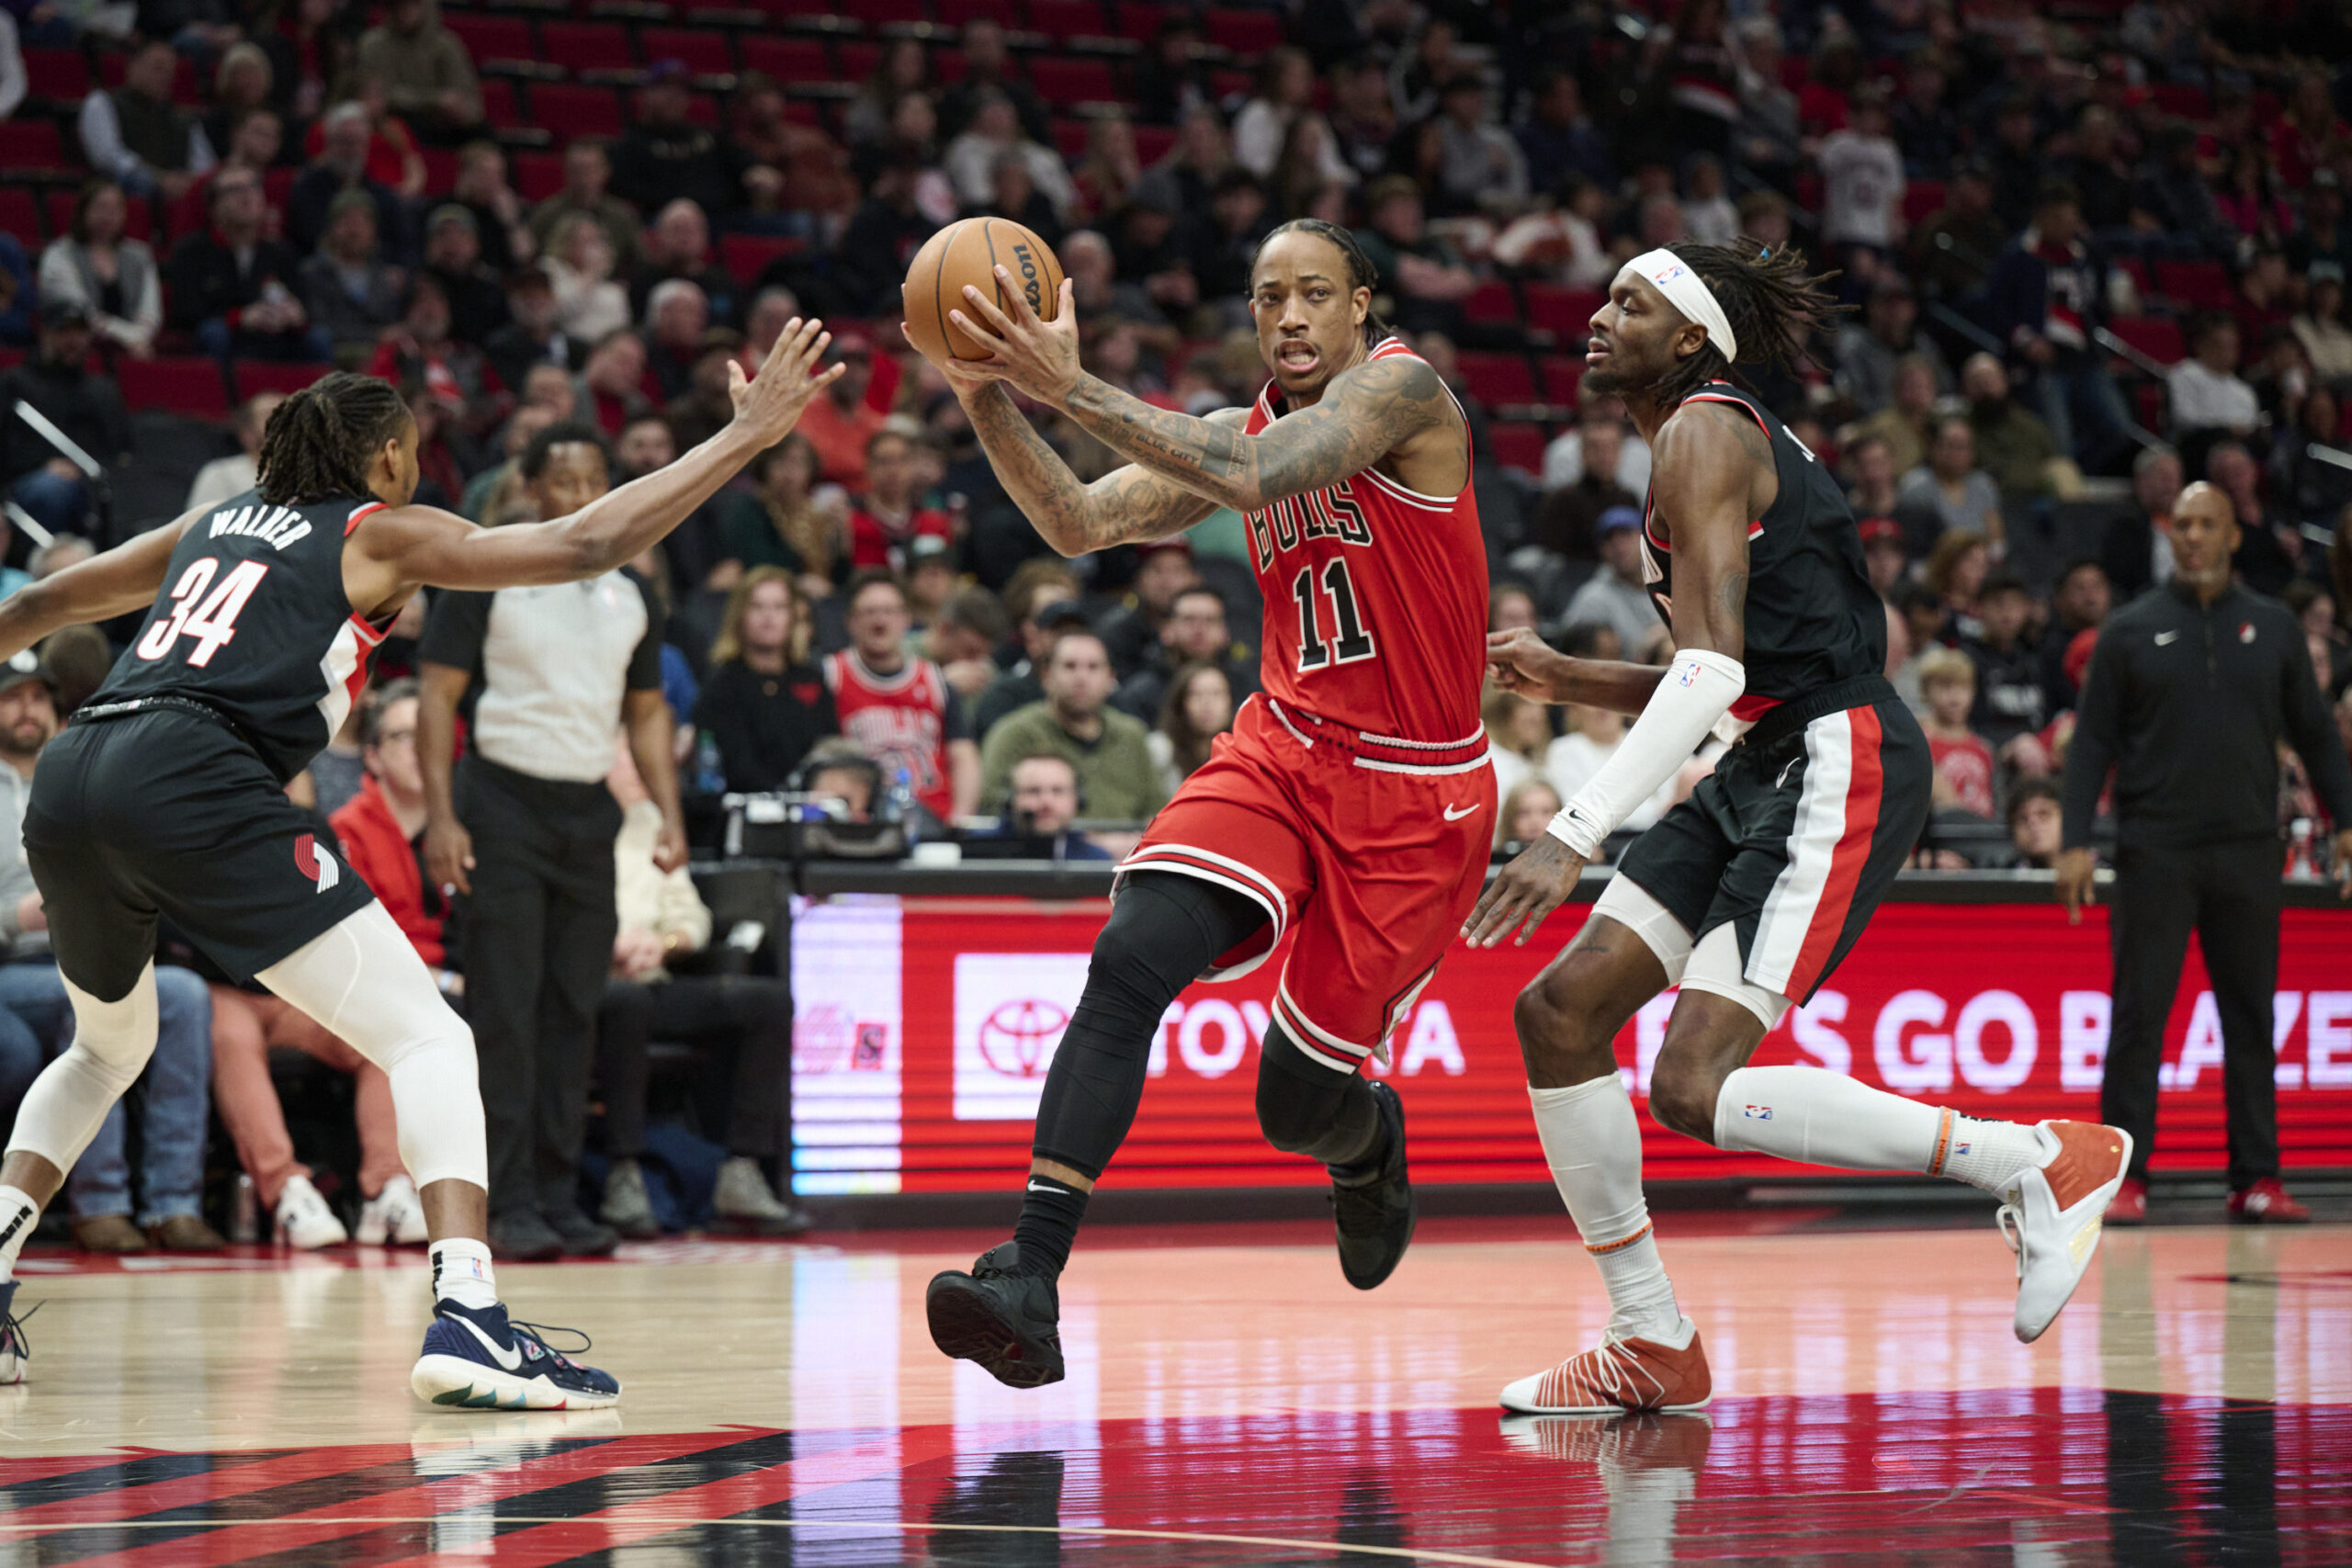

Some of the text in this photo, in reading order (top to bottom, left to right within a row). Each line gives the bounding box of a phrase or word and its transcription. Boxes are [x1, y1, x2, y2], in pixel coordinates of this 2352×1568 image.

[1136, 433, 1166, 453] BLUE
[1170, 446, 1199, 464] CITY
[209, 504, 313, 551] WALKER
[136, 557, 269, 668] 34
[1293, 556, 1376, 673] 11
[1148, 998, 1465, 1077] TOA
[1872, 989, 2039, 1092] GO
